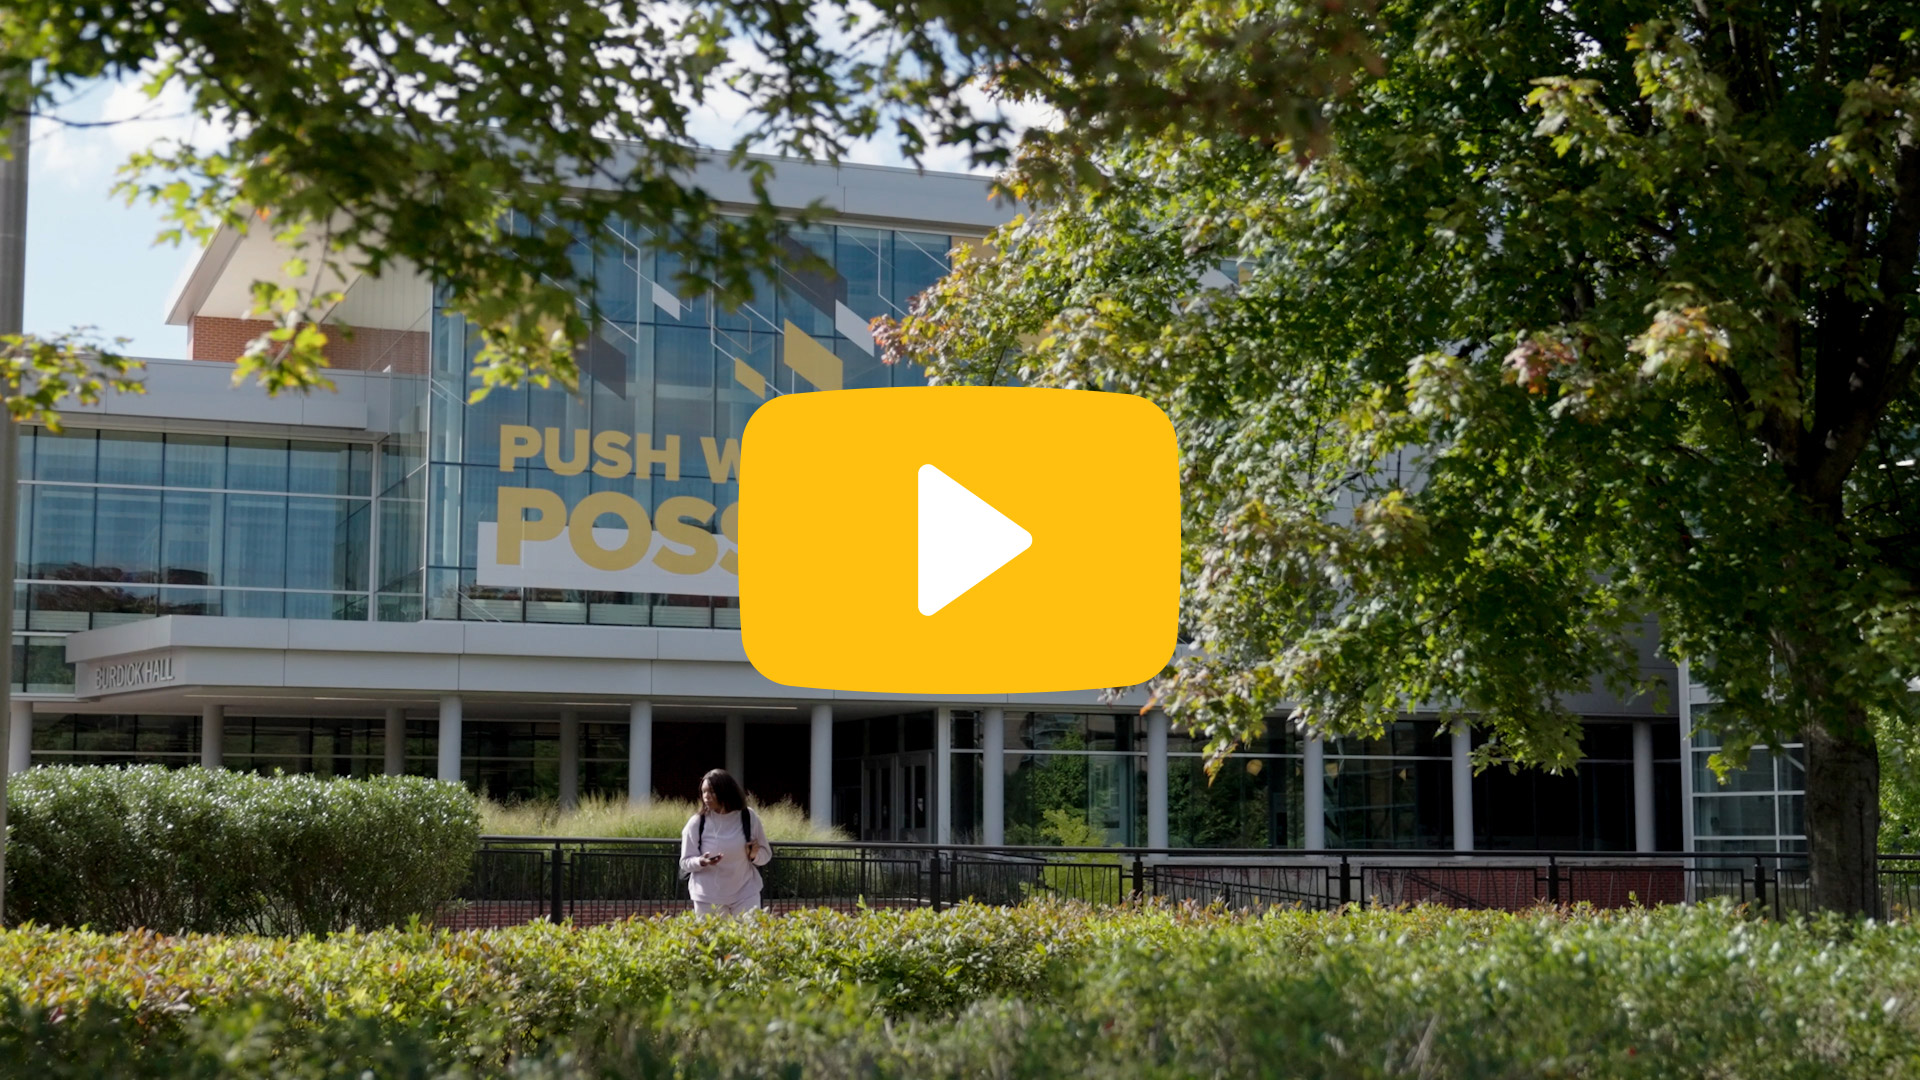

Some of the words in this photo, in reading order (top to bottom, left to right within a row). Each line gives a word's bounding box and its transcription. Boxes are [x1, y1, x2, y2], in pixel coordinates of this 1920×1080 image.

[499, 424, 680, 482] PUSH
[95, 662, 144, 690] BURDICK
[145, 657, 175, 683] HALL
